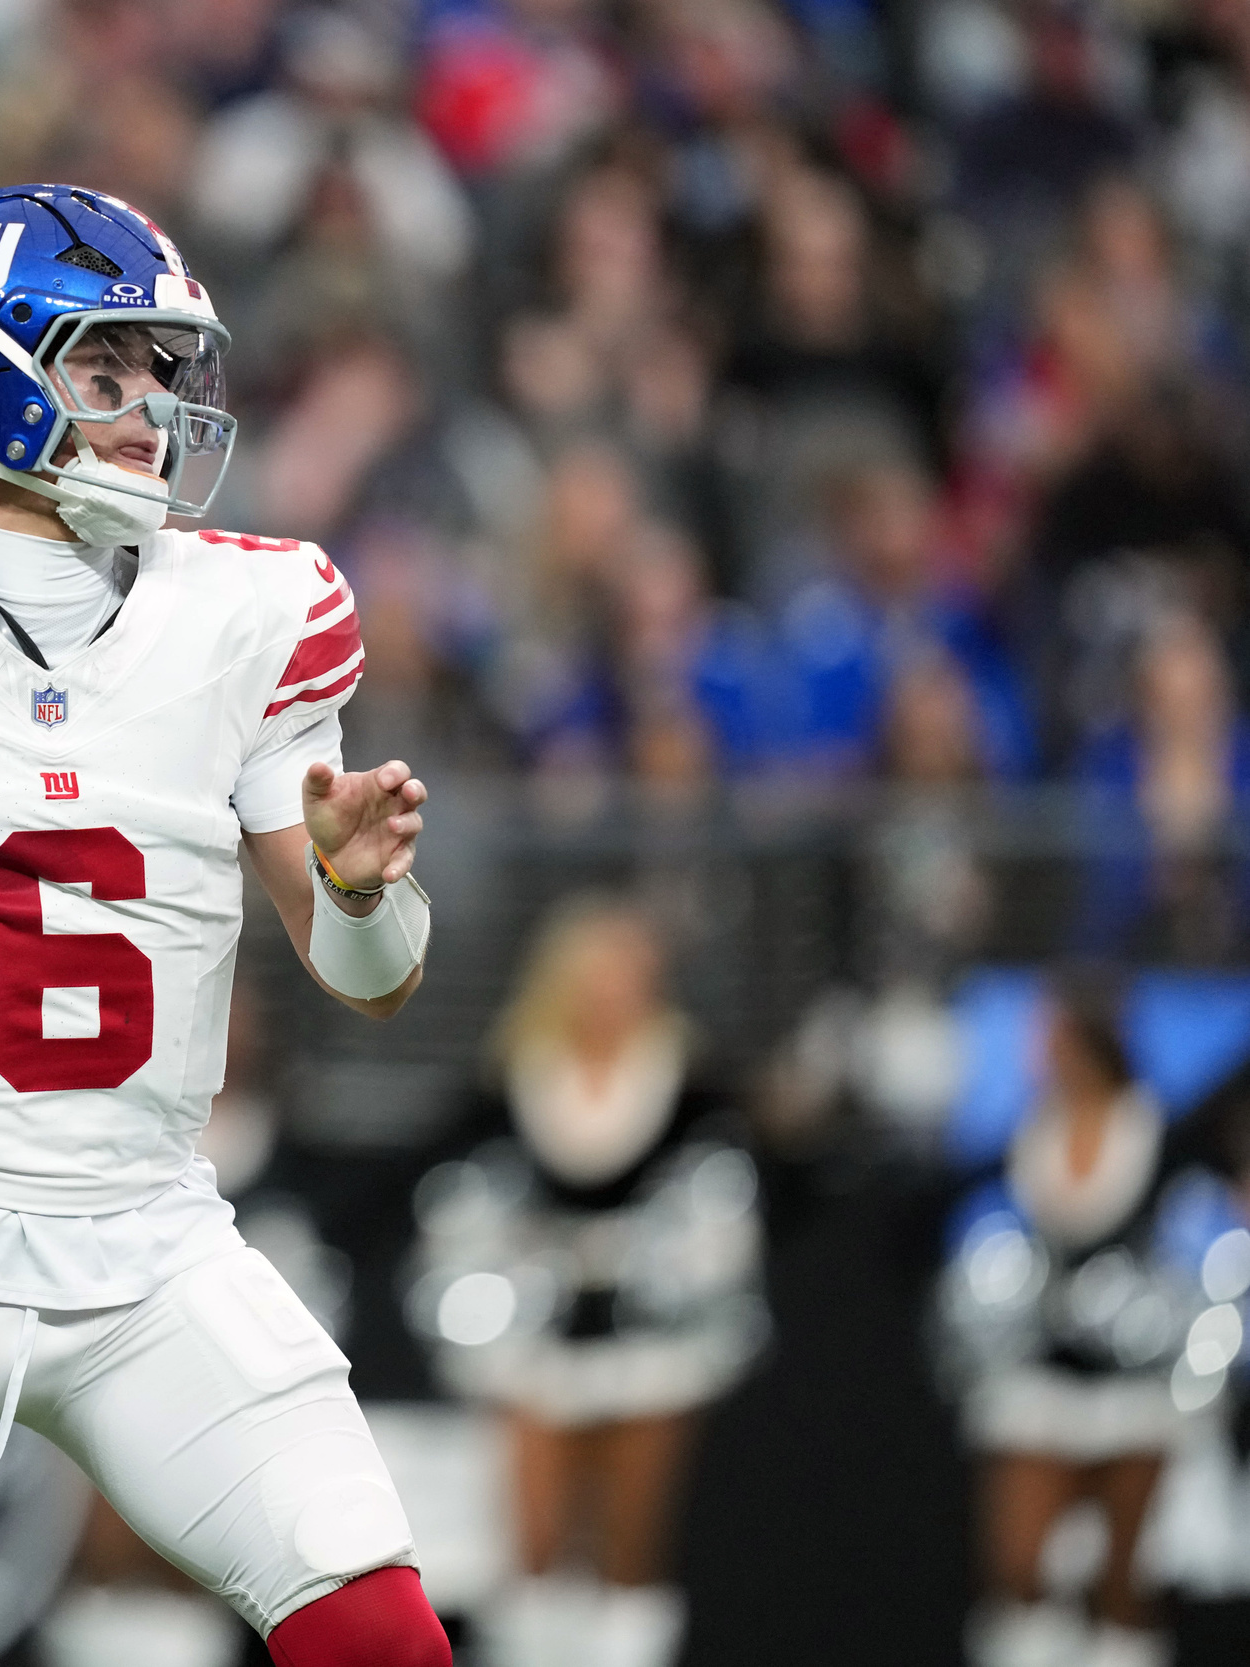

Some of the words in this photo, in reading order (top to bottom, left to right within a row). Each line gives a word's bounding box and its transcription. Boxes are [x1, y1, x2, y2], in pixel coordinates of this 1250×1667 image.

[104, 295, 150, 307] OAKLEY
[37, 704, 62, 722] NFL
[40, 771, 80, 800] ny
[323, 874, 347, 896] HYPE
